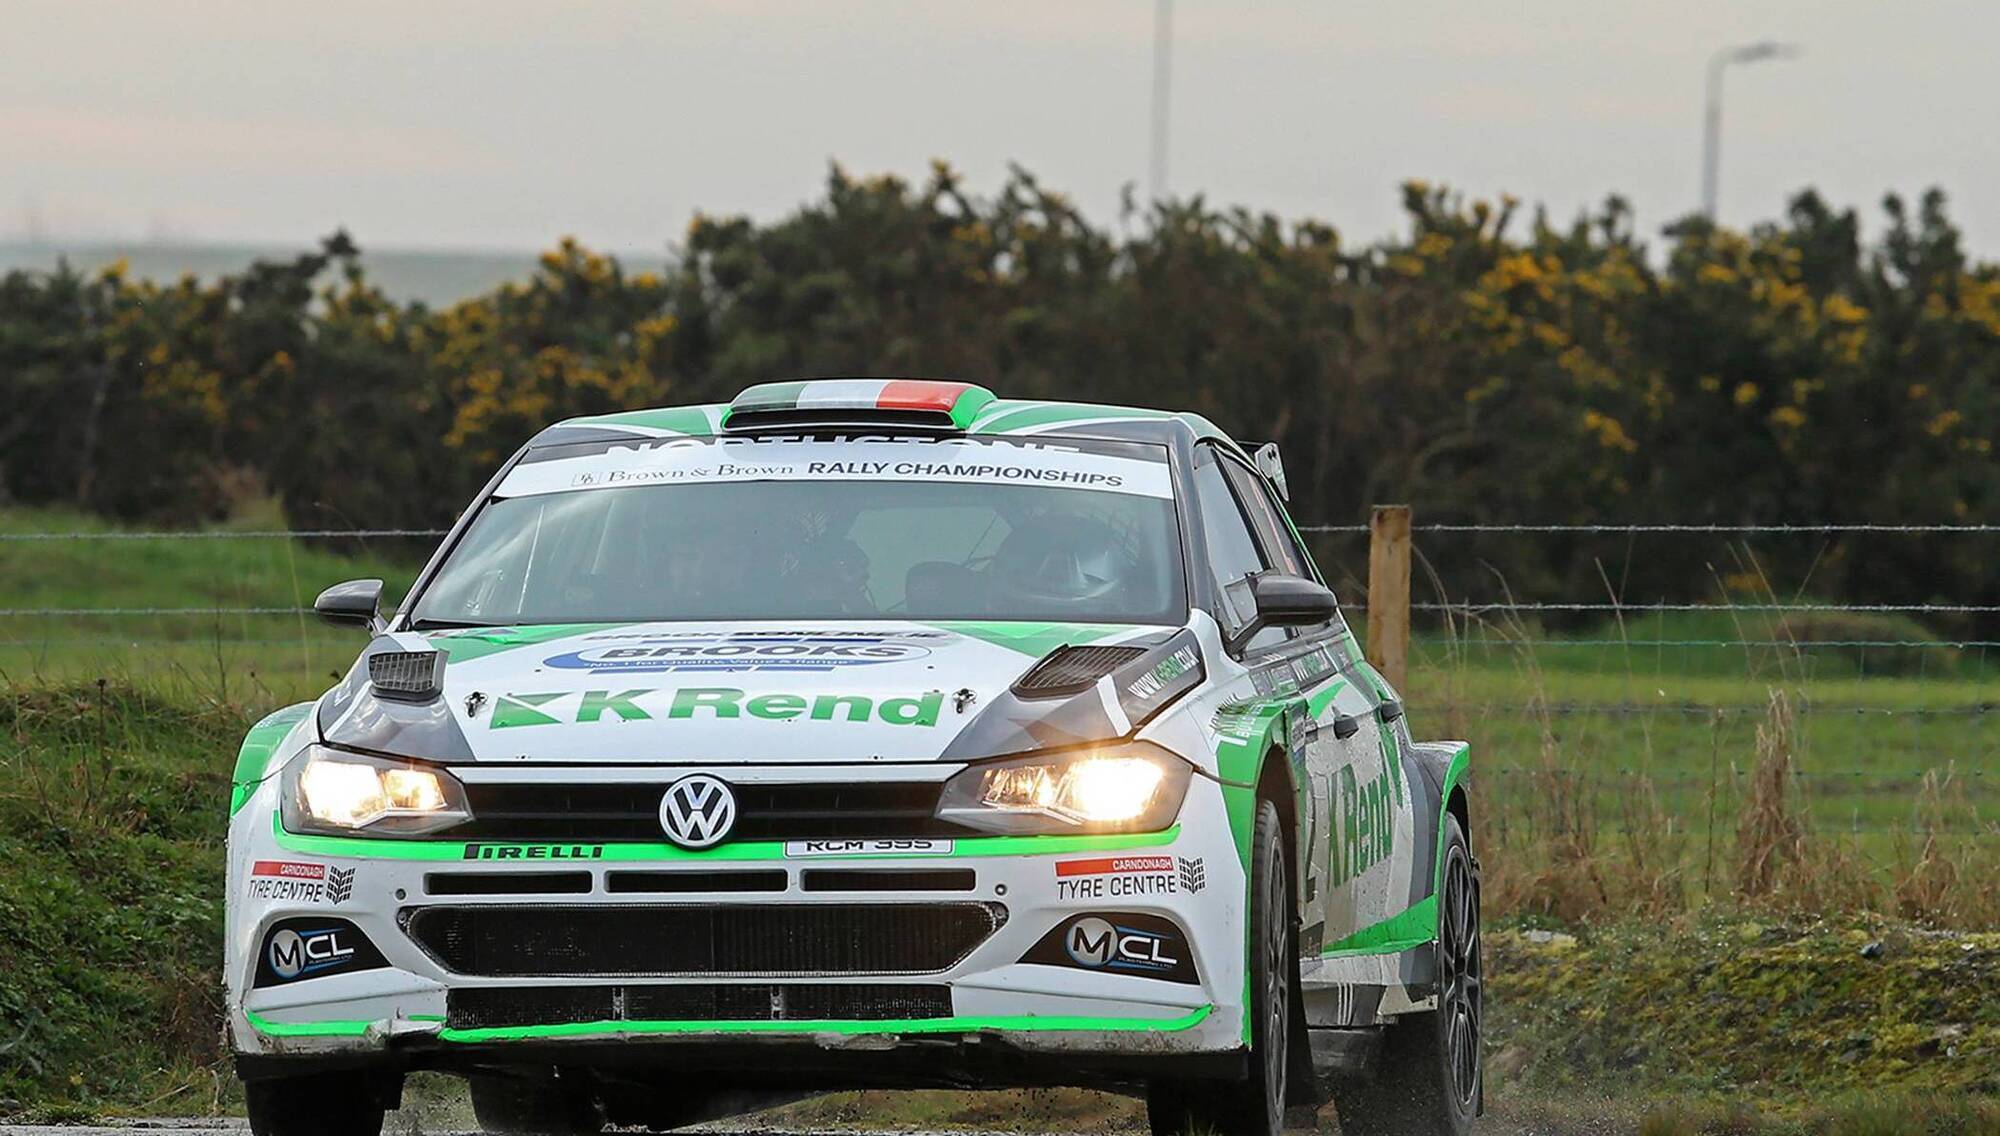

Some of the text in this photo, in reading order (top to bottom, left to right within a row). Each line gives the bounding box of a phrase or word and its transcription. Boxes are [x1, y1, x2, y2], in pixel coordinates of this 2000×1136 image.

[607, 470, 684, 482] Brown
[690, 467, 710, 478] &
[717, 464, 793, 476] Brown
[807, 461, 889, 475] RALLY
[894, 462, 1124, 487] CHAMPIONSHIPS
[600, 645, 909, 658] BROOKS
[575, 687, 945, 727] K Rend
[280, 863, 324, 878] CARNDONAGH
[1112, 857, 1173, 871] CARNDONAGH
[249, 880, 324, 903] TYRE CENTRE
[1057, 875, 1178, 900] TYRE CENTRE
[272, 933, 355, 971] MCL
[1073, 926, 1177, 965] MCL
